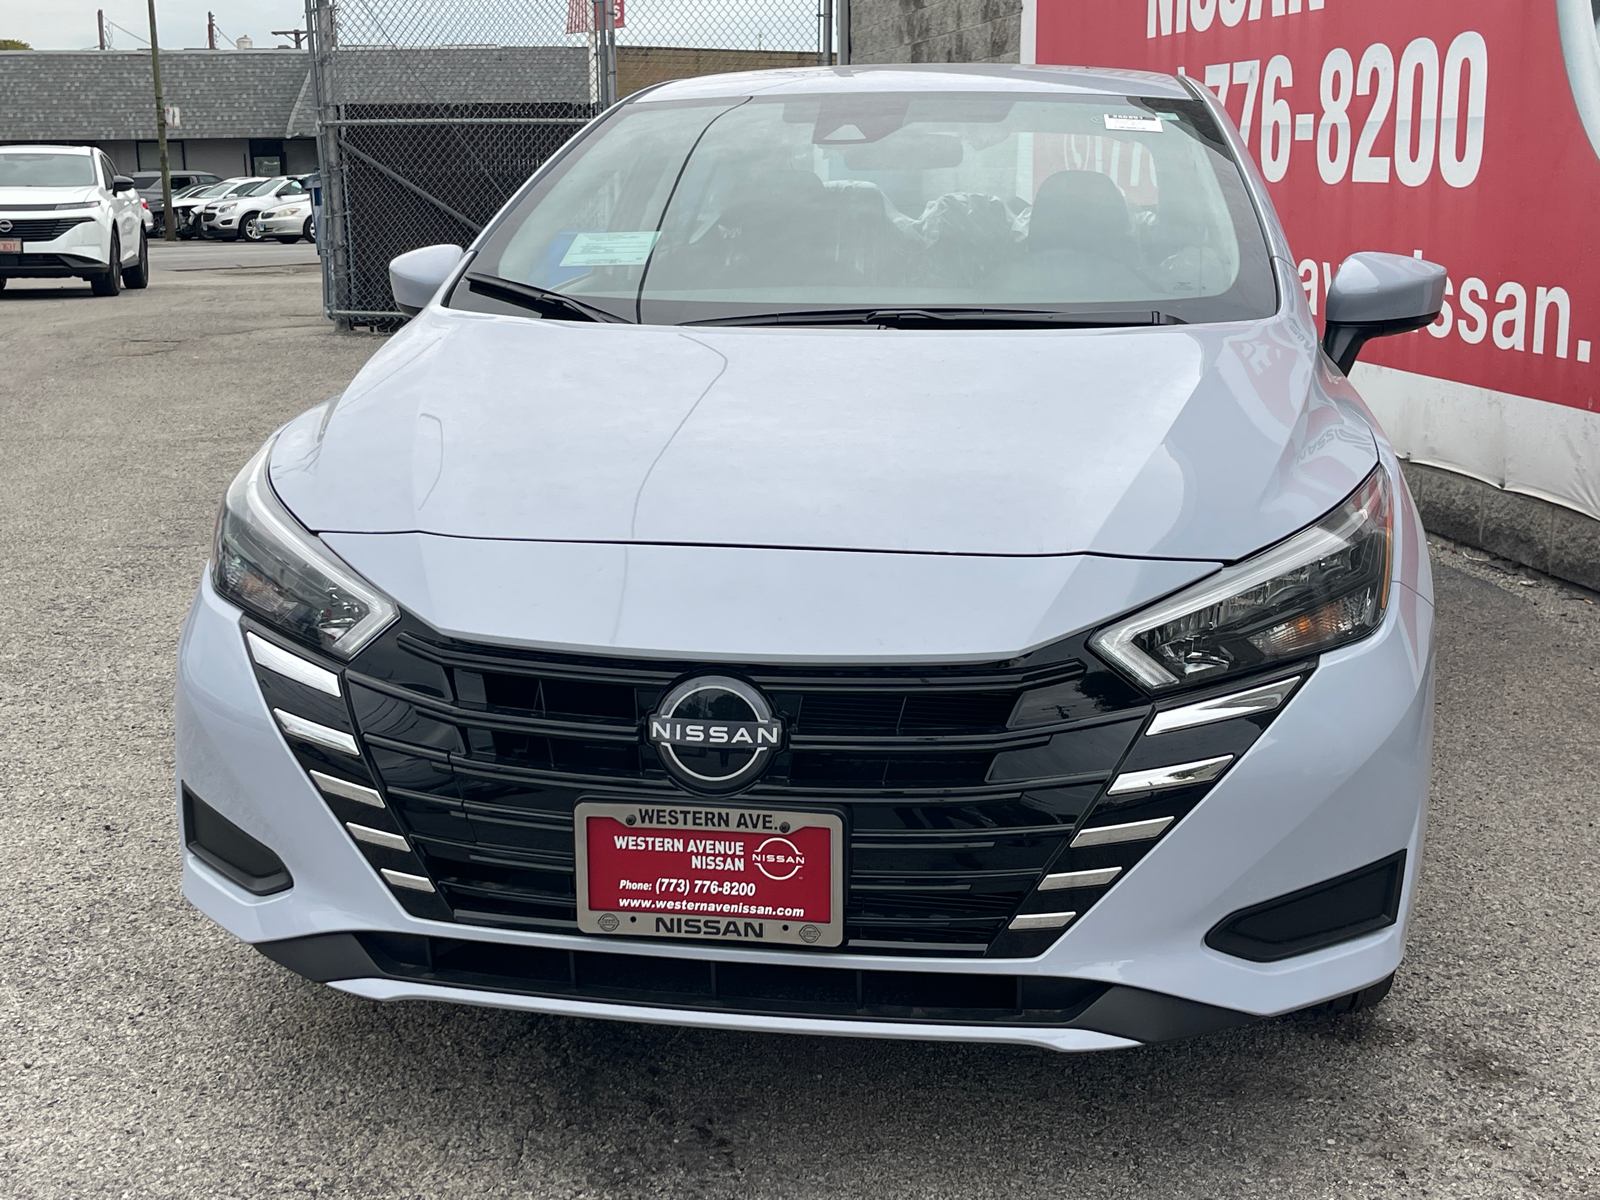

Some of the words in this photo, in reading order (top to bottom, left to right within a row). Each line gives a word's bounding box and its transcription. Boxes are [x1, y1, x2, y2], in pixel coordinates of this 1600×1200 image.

[652, 721, 778, 744] NISSAN
[638, 808, 730, 828] WESTERN
[736, 813, 779, 831] AVE.
[614, 835, 684, 853] WESTERN
[687, 839, 745, 856] AVENUE
[691, 855, 745, 872] NISSAN
[752, 853, 805, 864] NISSAN
[619, 879, 652, 891] Phone:
[655, 877, 690, 896] (773)
[694, 879, 756, 897] 776-8200
[618, 897, 805, 918] www.westernavenissan.com
[655, 916, 764, 938] NISSAN
